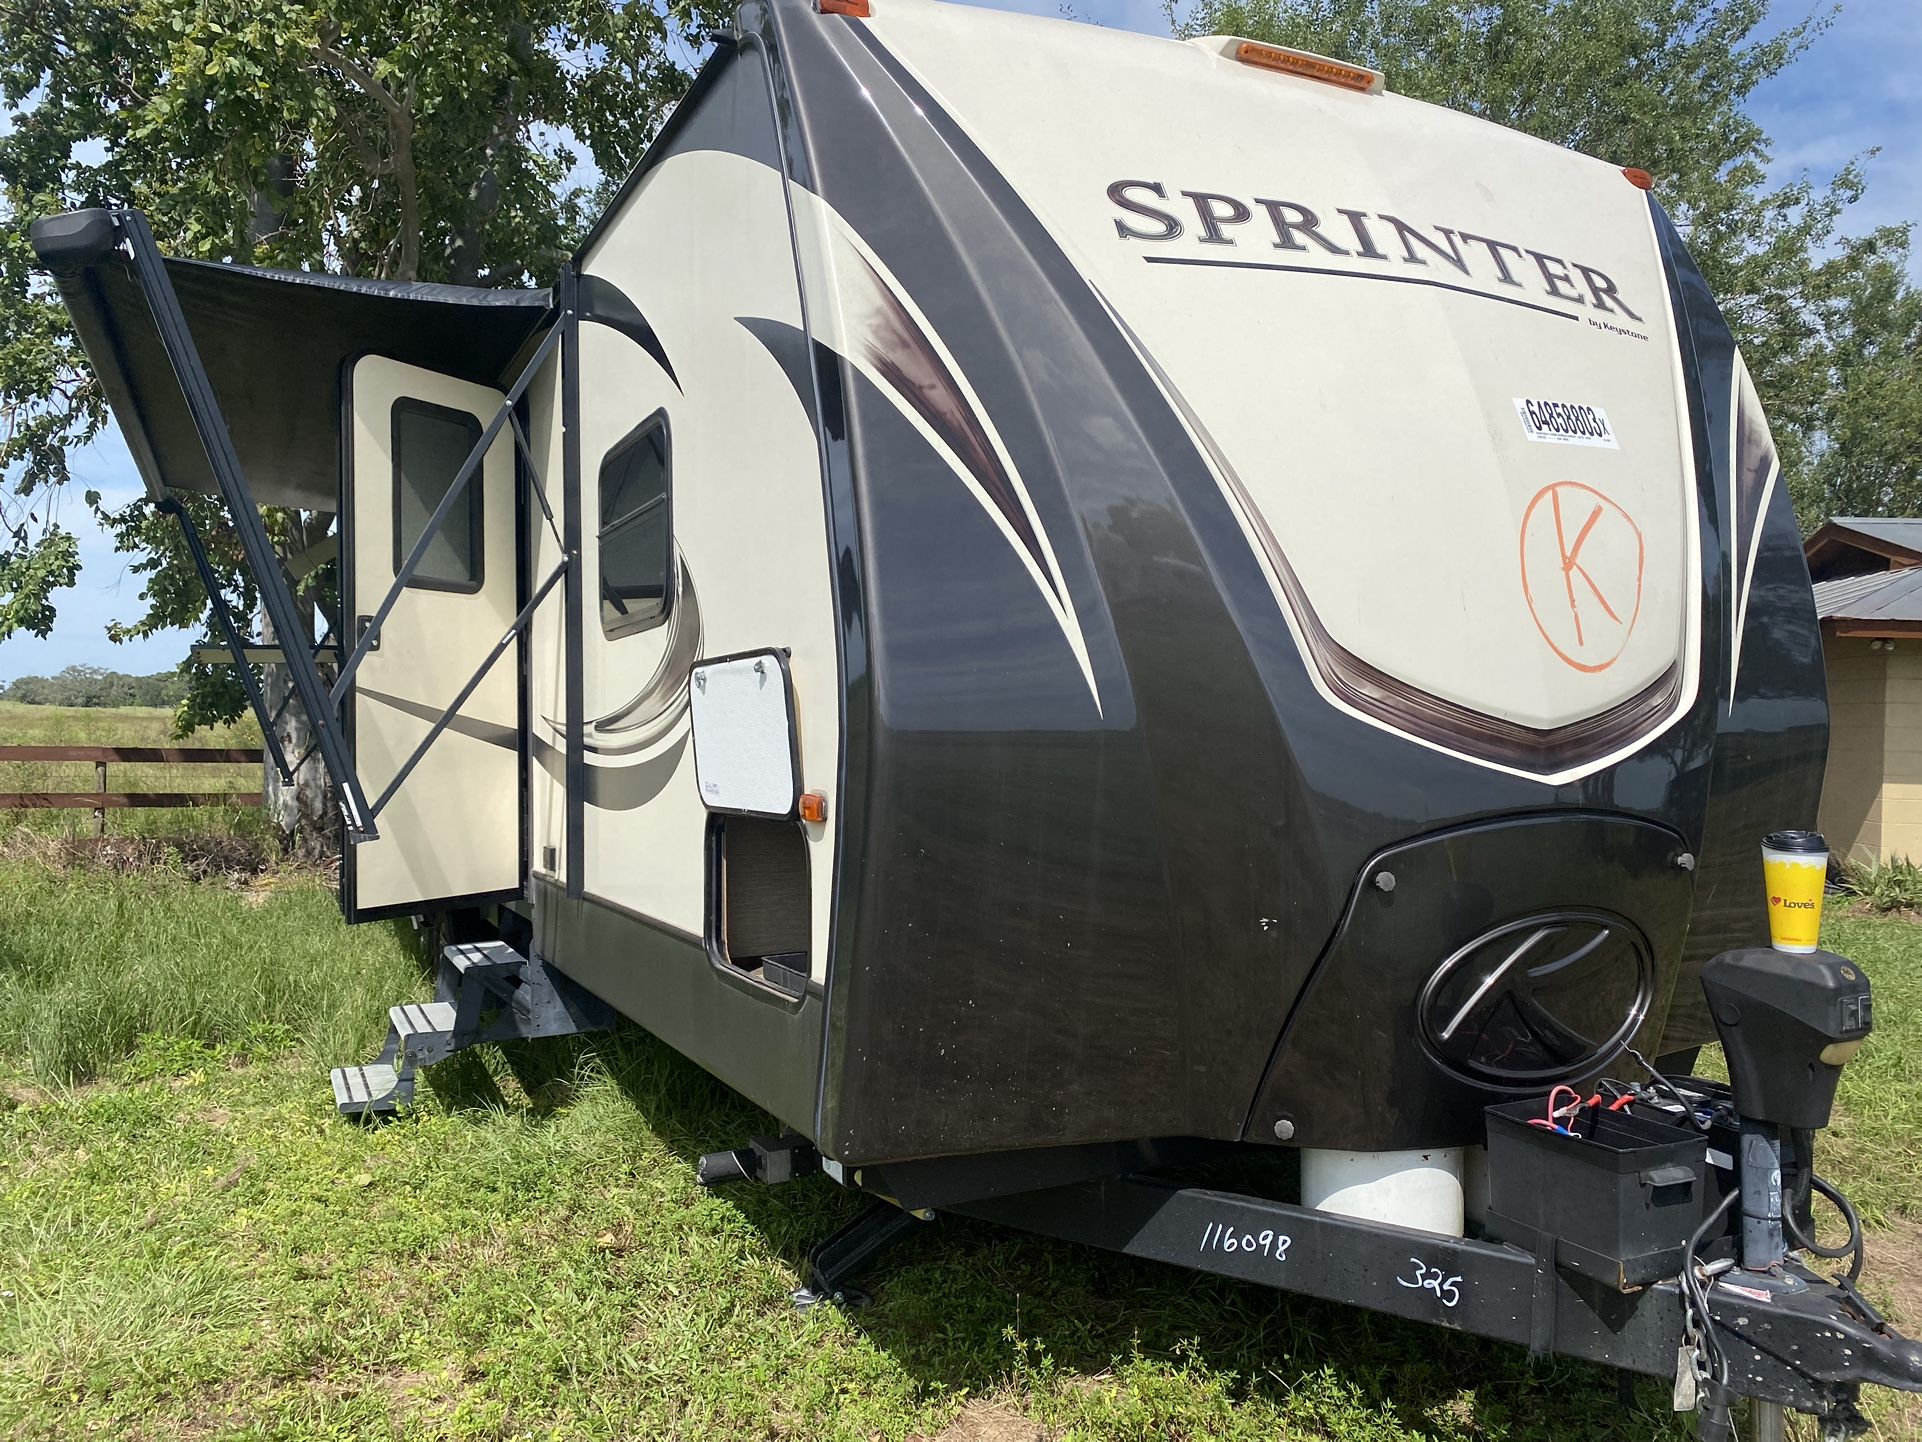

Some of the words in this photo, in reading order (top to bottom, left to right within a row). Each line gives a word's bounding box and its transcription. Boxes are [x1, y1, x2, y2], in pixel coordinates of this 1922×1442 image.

[1106, 179, 1644, 323] SPRINTER
[1588, 318, 1602, 330] by
[1602, 322, 1649, 341] Keystone
[1783, 898, 1816, 910] Love's
[1200, 1222, 1292, 1262] 116098
[1396, 1257, 1463, 1307] 325
